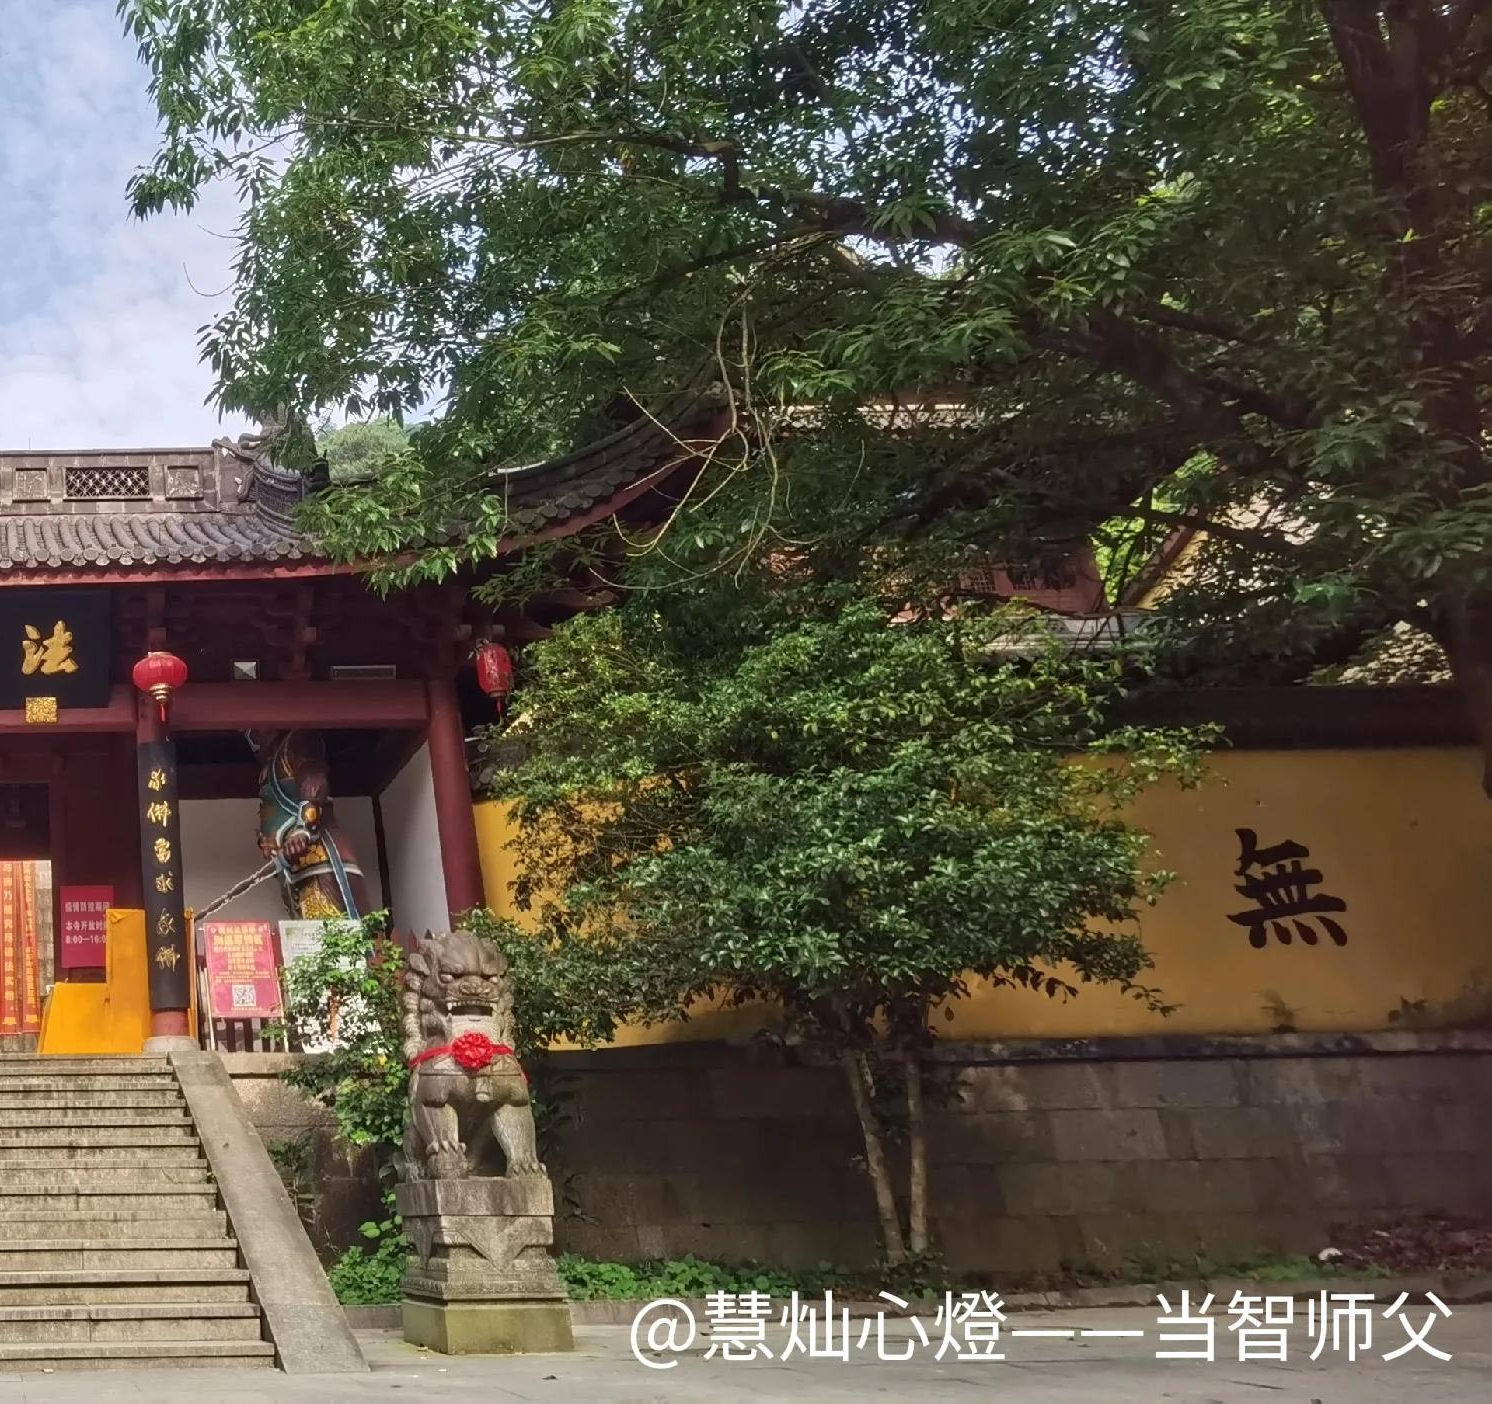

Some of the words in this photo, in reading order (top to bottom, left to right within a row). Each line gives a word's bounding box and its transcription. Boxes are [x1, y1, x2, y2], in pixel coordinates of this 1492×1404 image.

[1225, 827, 1348, 950] 無
[65, 920, 107, 932] 本寺开放时
